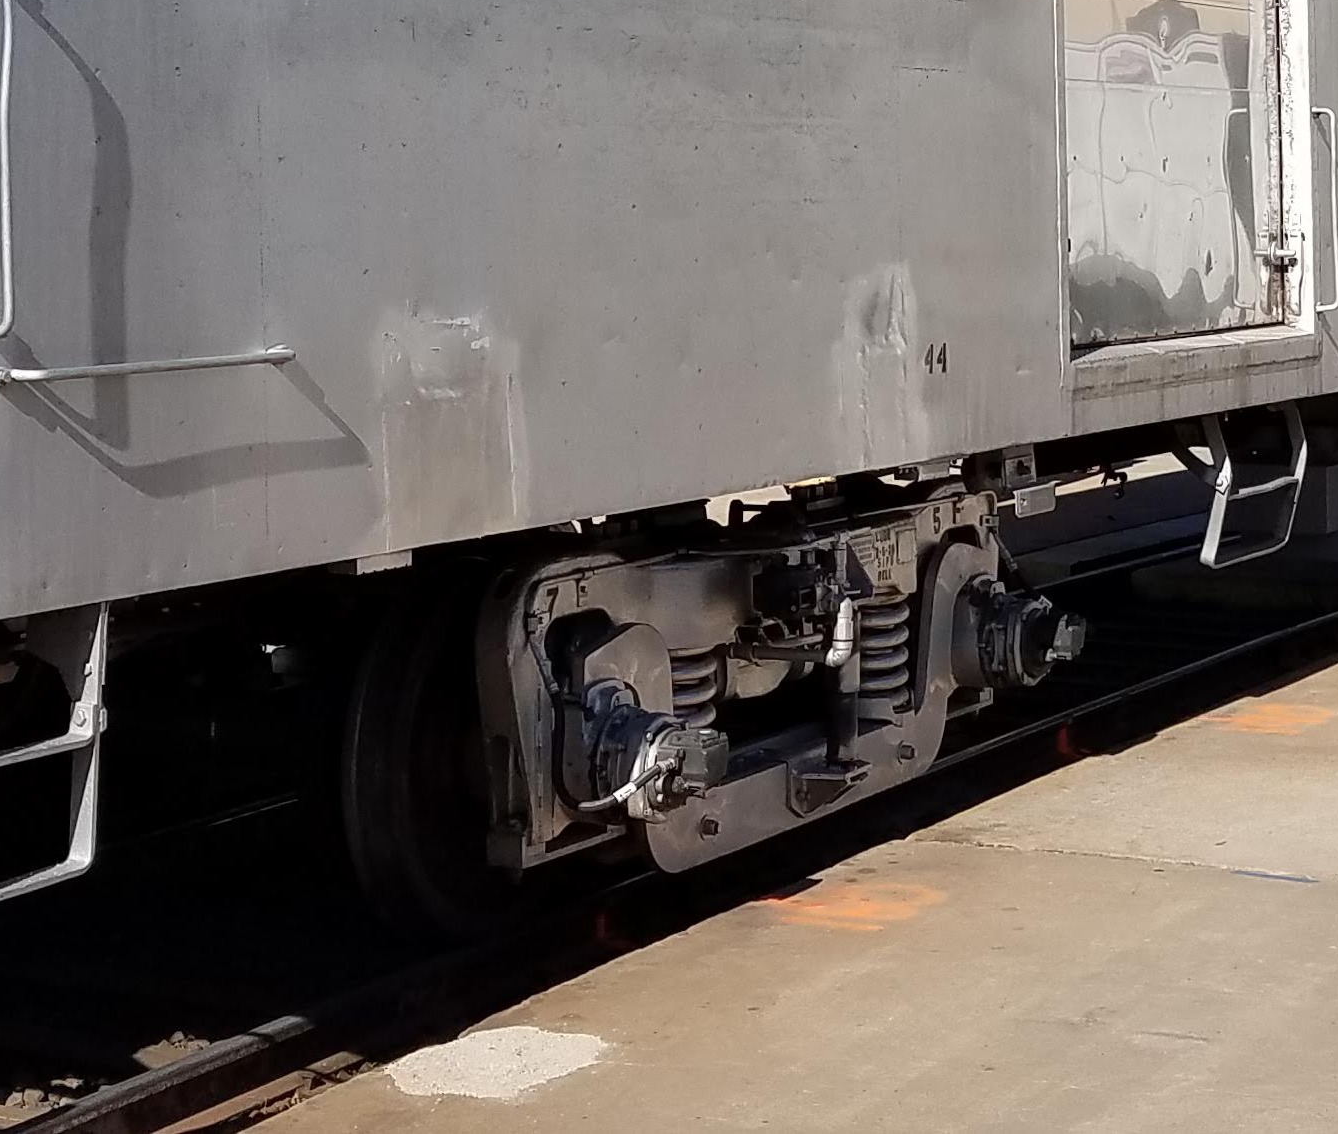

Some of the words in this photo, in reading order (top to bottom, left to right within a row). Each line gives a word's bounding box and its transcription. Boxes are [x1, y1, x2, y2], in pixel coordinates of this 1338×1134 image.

[924, 342, 947, 374] 44
[933, 506, 941, 534] 5
[546, 586, 559, 622] 7
